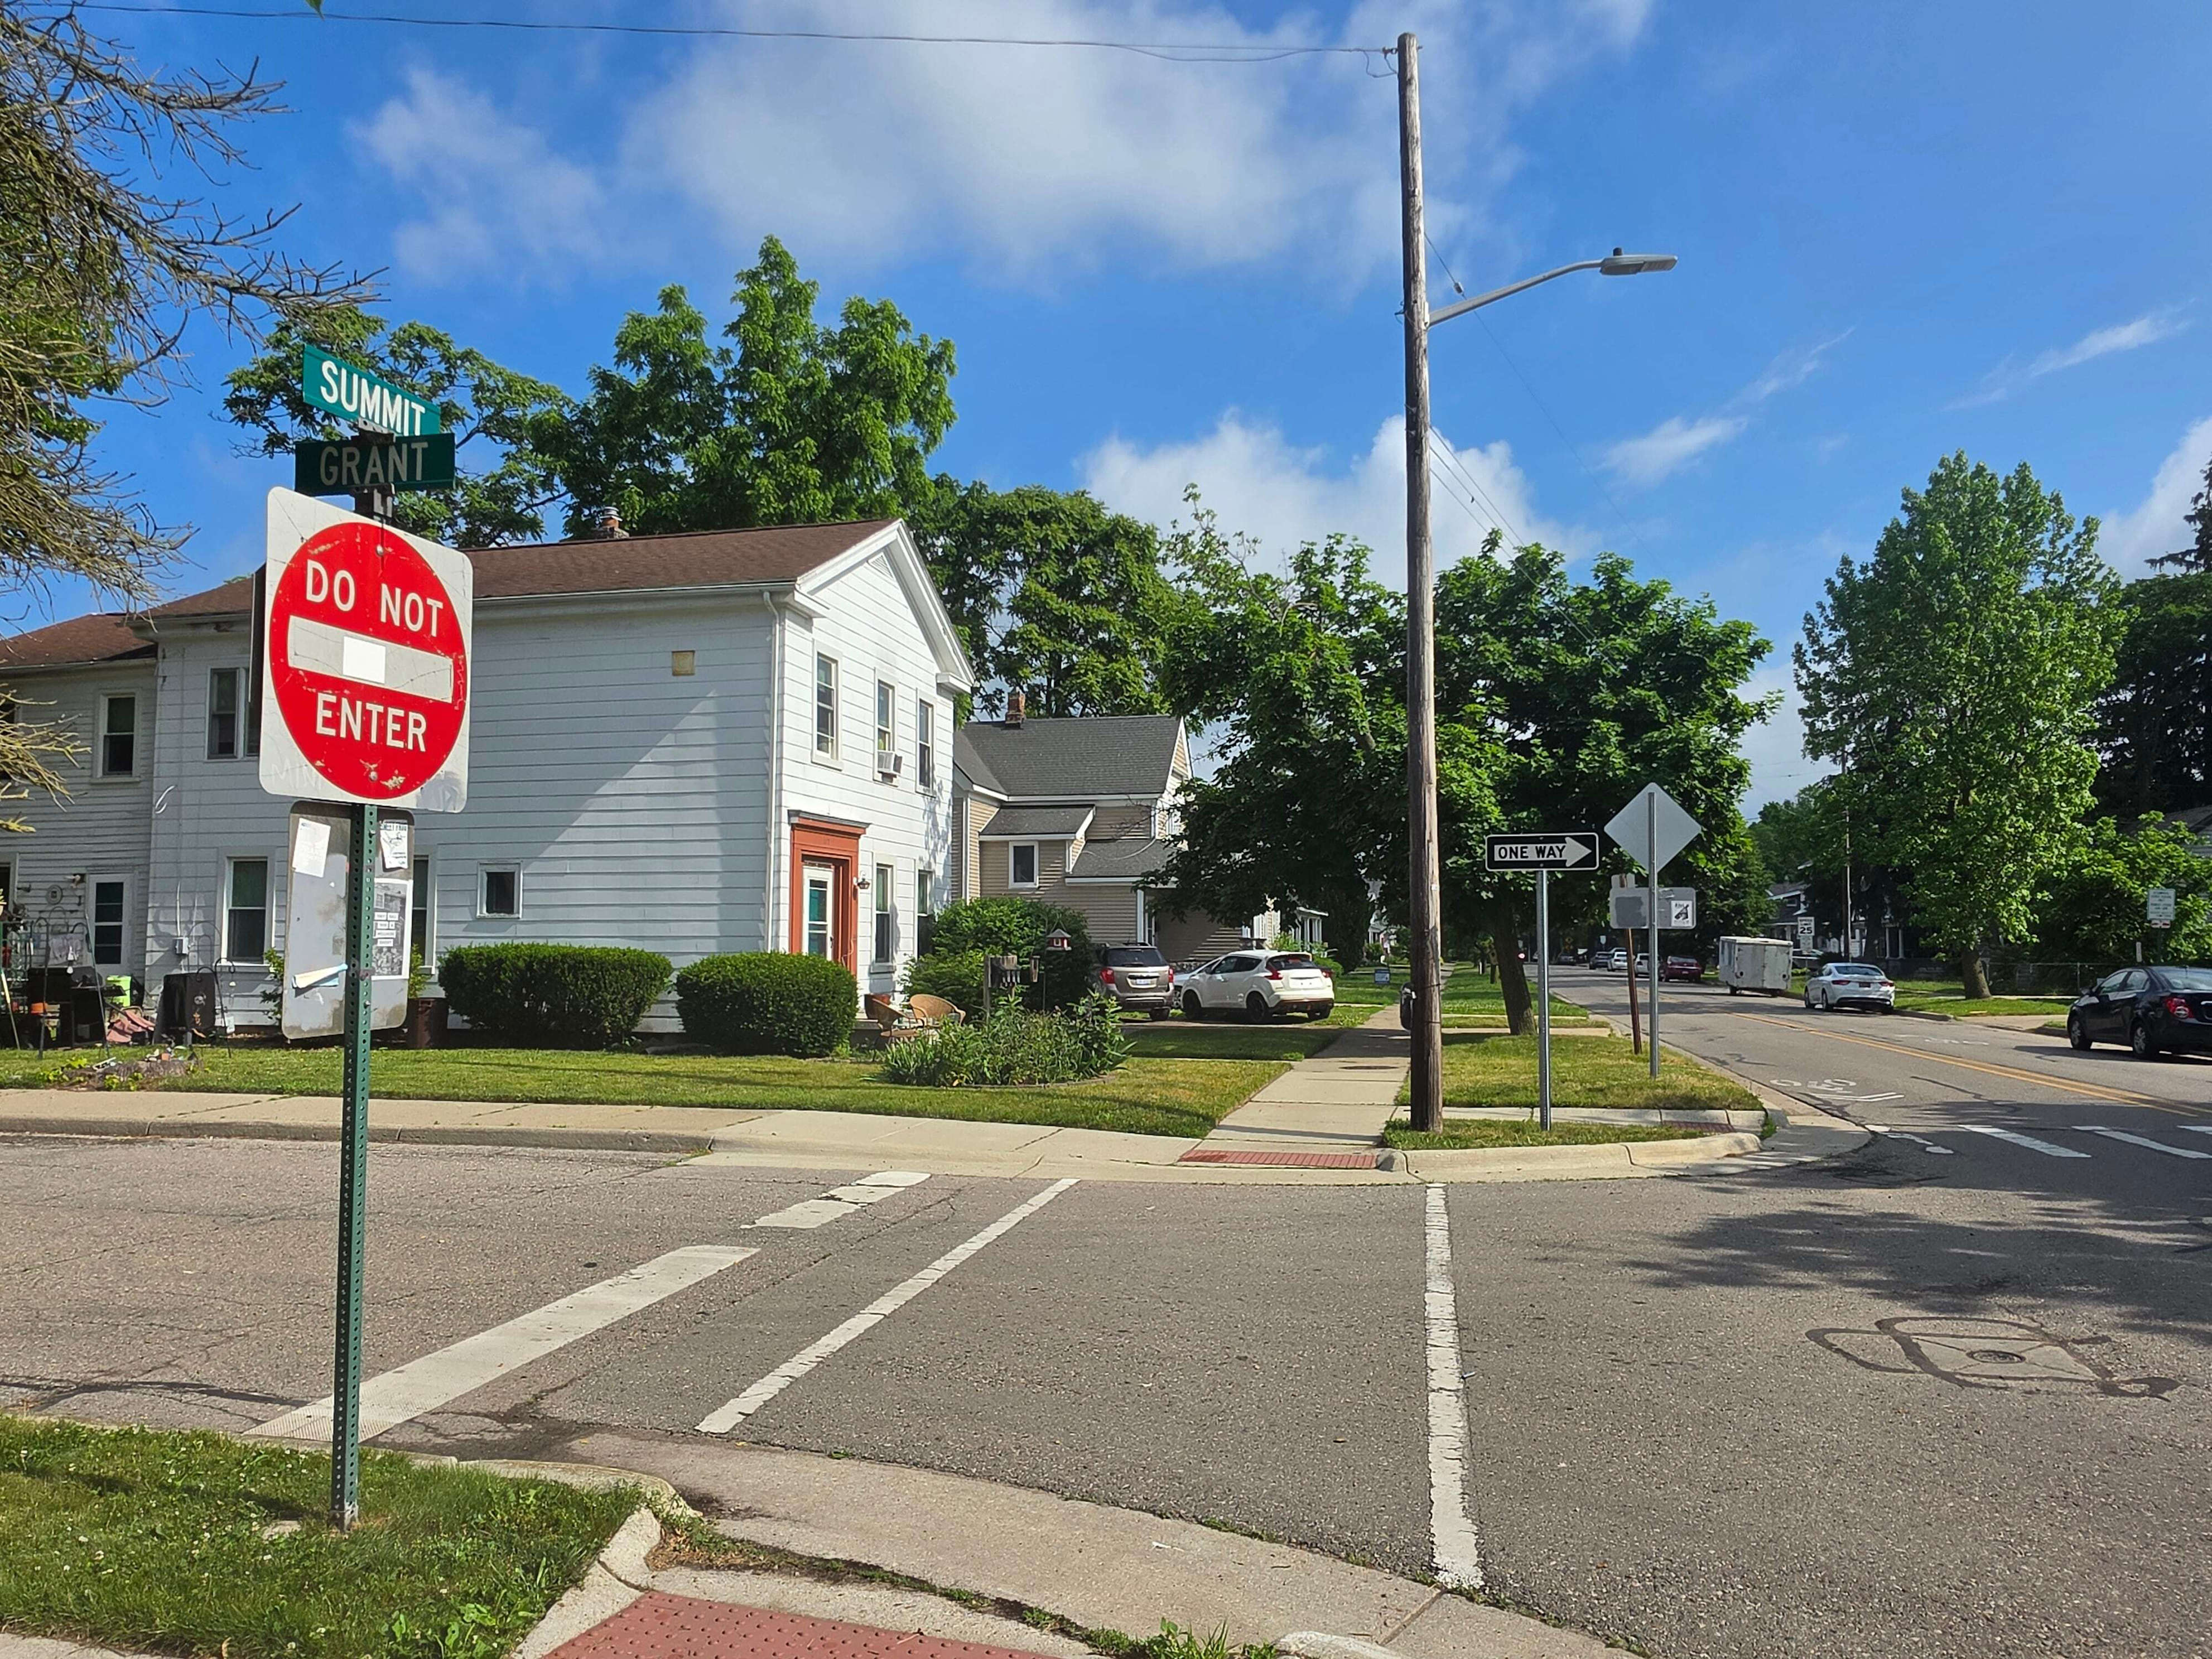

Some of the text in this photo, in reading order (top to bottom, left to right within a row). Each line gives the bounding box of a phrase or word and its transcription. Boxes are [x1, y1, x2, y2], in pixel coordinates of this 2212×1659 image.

[320, 360, 426, 437] SUMMIT
[320, 442, 428, 486] GRANT
[305, 559, 444, 638] DO NOT
[316, 692, 427, 752] ENTER
[1498, 845, 1566, 859] ONE WAY
